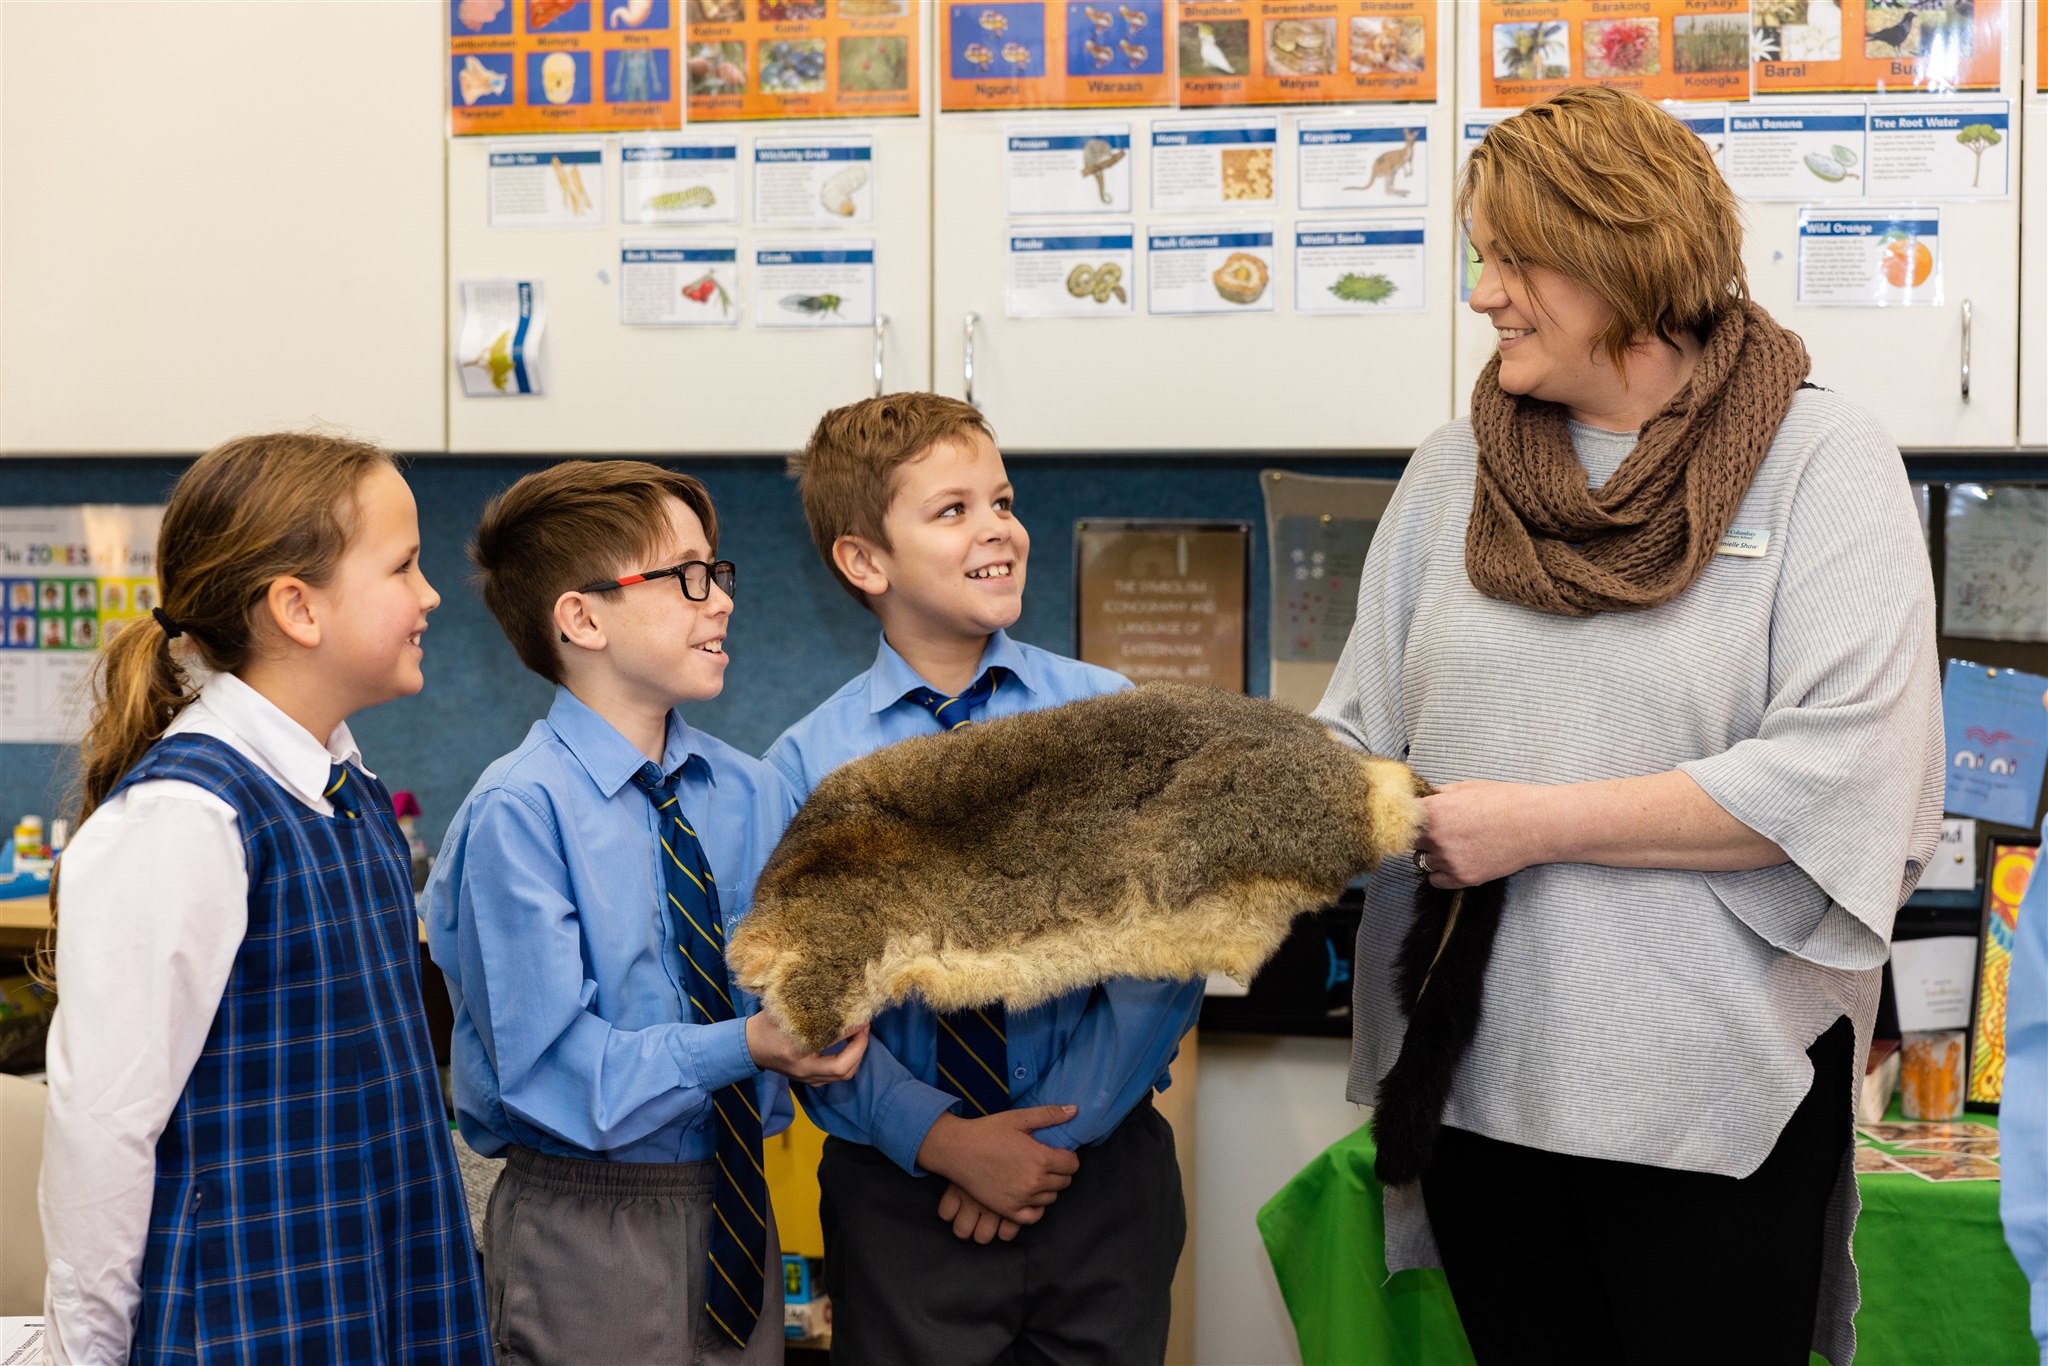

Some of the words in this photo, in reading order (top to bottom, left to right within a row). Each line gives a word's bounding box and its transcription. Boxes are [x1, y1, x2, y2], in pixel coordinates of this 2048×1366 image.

[1764, 63, 1807, 78] Baral
[1684, 75, 1740, 89] Koongka
[1733, 118, 1760, 130] Bush
[1762, 118, 1804, 130] Banana
[1873, 118, 1897, 129] Tree
[1898, 117, 1924, 128] Root
[1925, 116, 1961, 128] Water
[1805, 222, 1831, 235] Wild
[1833, 222, 1873, 236] Orange
[26, 543, 91, 566] ZONES
